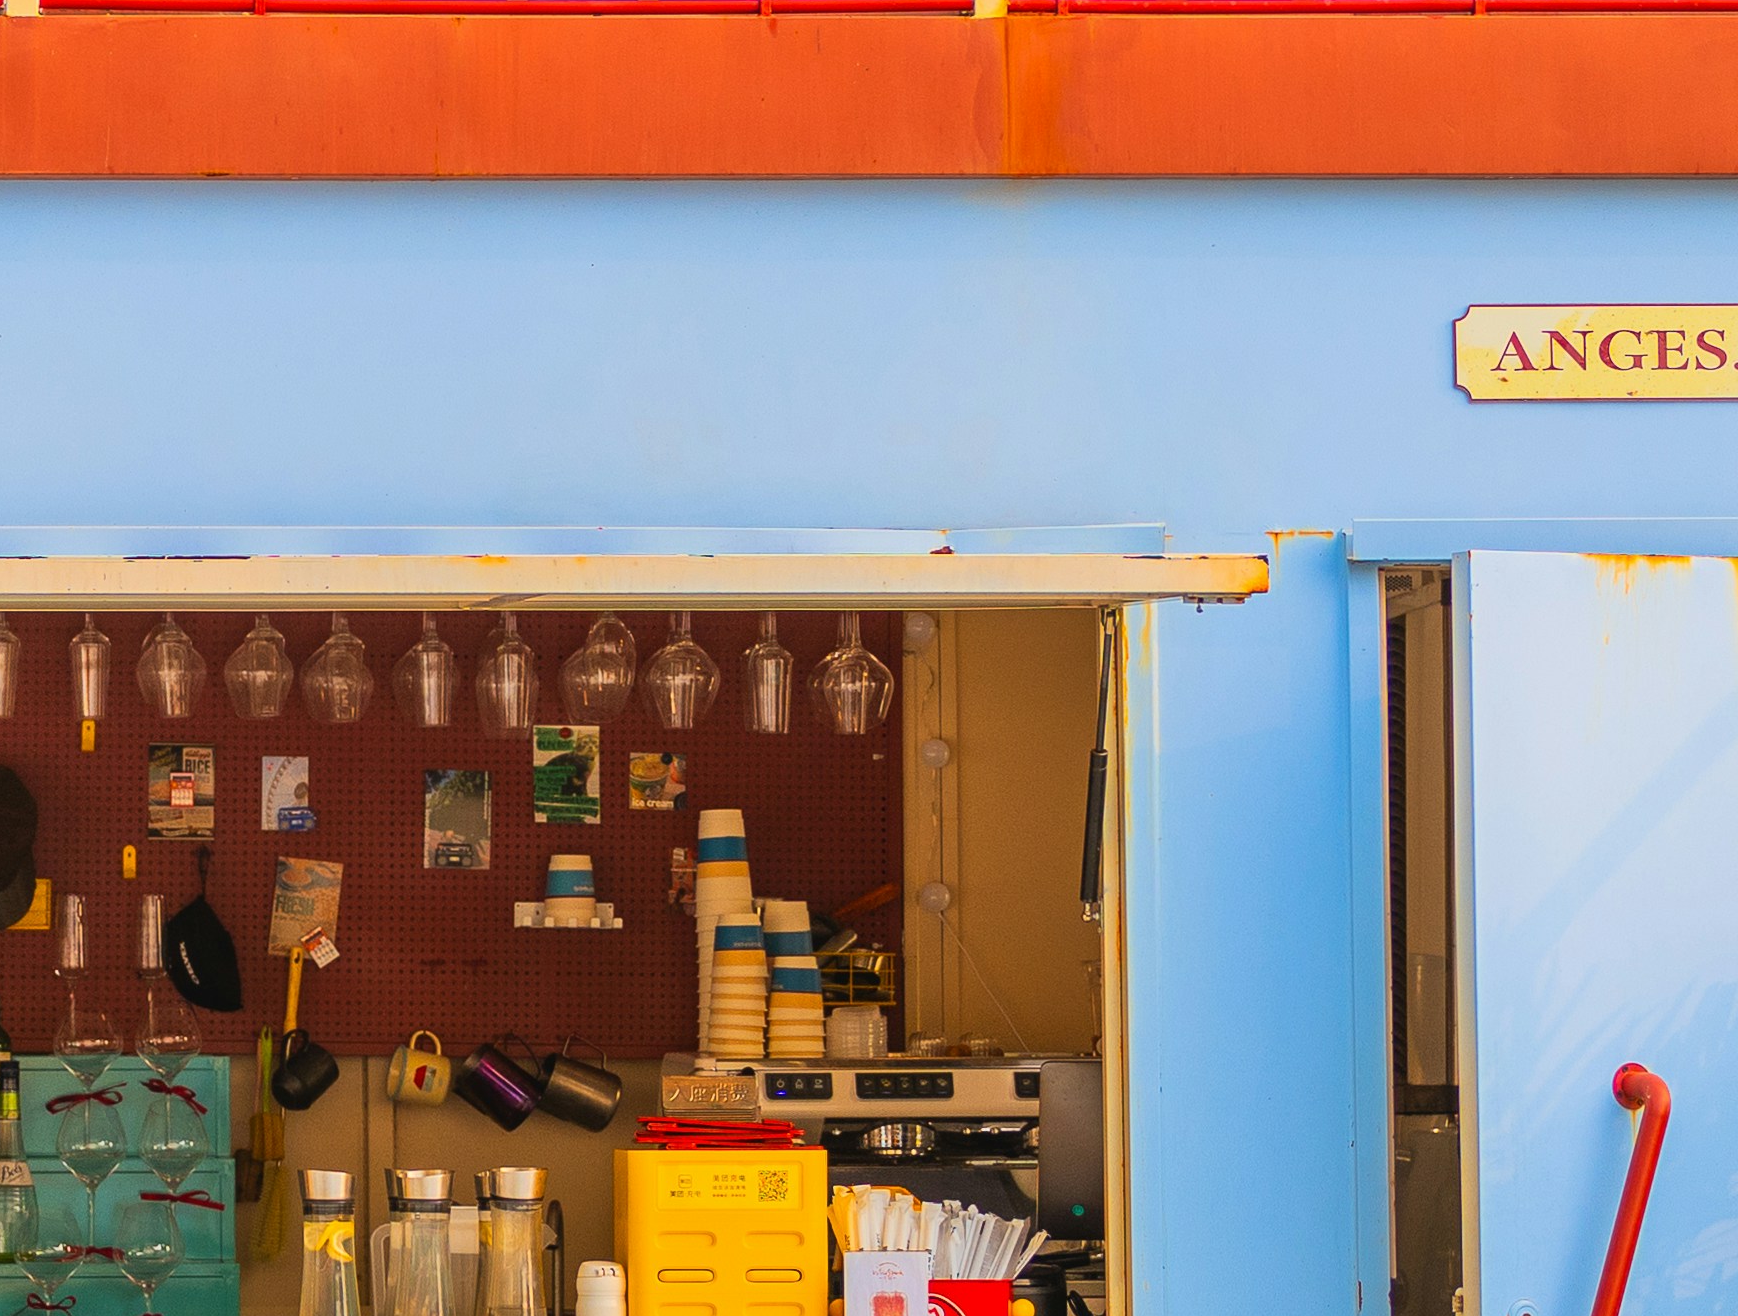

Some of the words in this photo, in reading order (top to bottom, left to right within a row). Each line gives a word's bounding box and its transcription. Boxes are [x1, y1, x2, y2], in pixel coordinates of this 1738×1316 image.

[184, 758, 212, 775] RICE
[631, 798, 645, 807] ice
[646, 799, 674, 808] cream
[275, 893, 316, 917] FRESH
